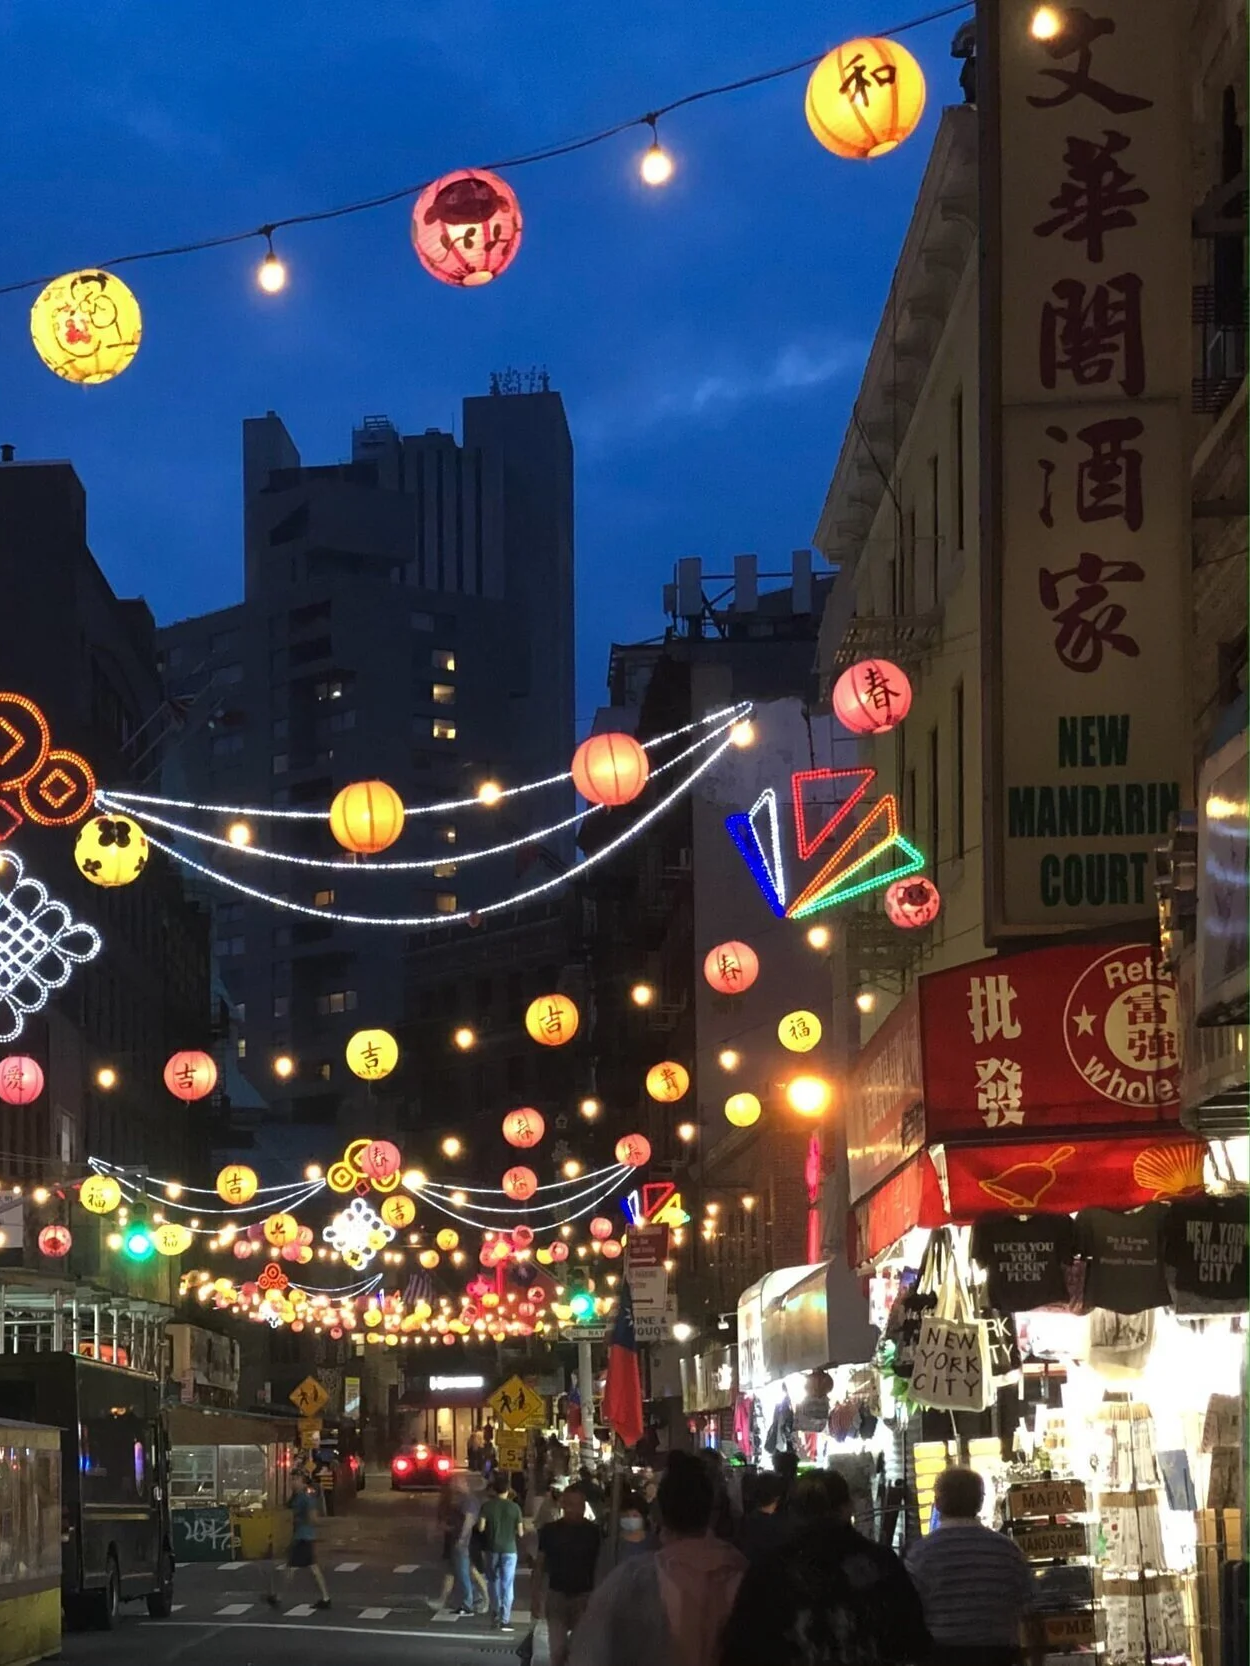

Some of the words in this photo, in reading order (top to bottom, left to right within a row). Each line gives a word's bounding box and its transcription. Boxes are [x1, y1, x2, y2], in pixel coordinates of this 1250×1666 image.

[839, 55, 897, 108] 和
[864, 668, 901, 711] 春
[1058, 714, 1130, 768] NEW
[1008, 782, 1180, 838] MANDARIN
[1039, 852, 1149, 908] COURT
[540, 1005, 564, 1034] 吉
[790, 1017, 810, 1041] 福
[1123, 991, 1177, 1063] 富強
[361, 1041, 381, 1069] 吉
[967, 974, 1025, 1128] 批發
[175, 1063, 196, 1089] 吉
[226, 1173, 243, 1195] 吉
[1219, 1223, 1248, 1246] YOR
[993, 1242, 1027, 1254] FUCK
[1029, 1241, 1054, 1253] YOU
[1010, 1252, 1037, 1263] YOU
[1199, 1262, 1235, 1284] CITY
[926, 1327, 976, 1350] NEW
[986, 1317, 1012, 1338] RK
[921, 1350, 981, 1375] YORK
[989, 1344, 1015, 1365] TY
[913, 1373, 980, 1398] CITY
[1022, 1490, 1073, 1510] MAFIA
